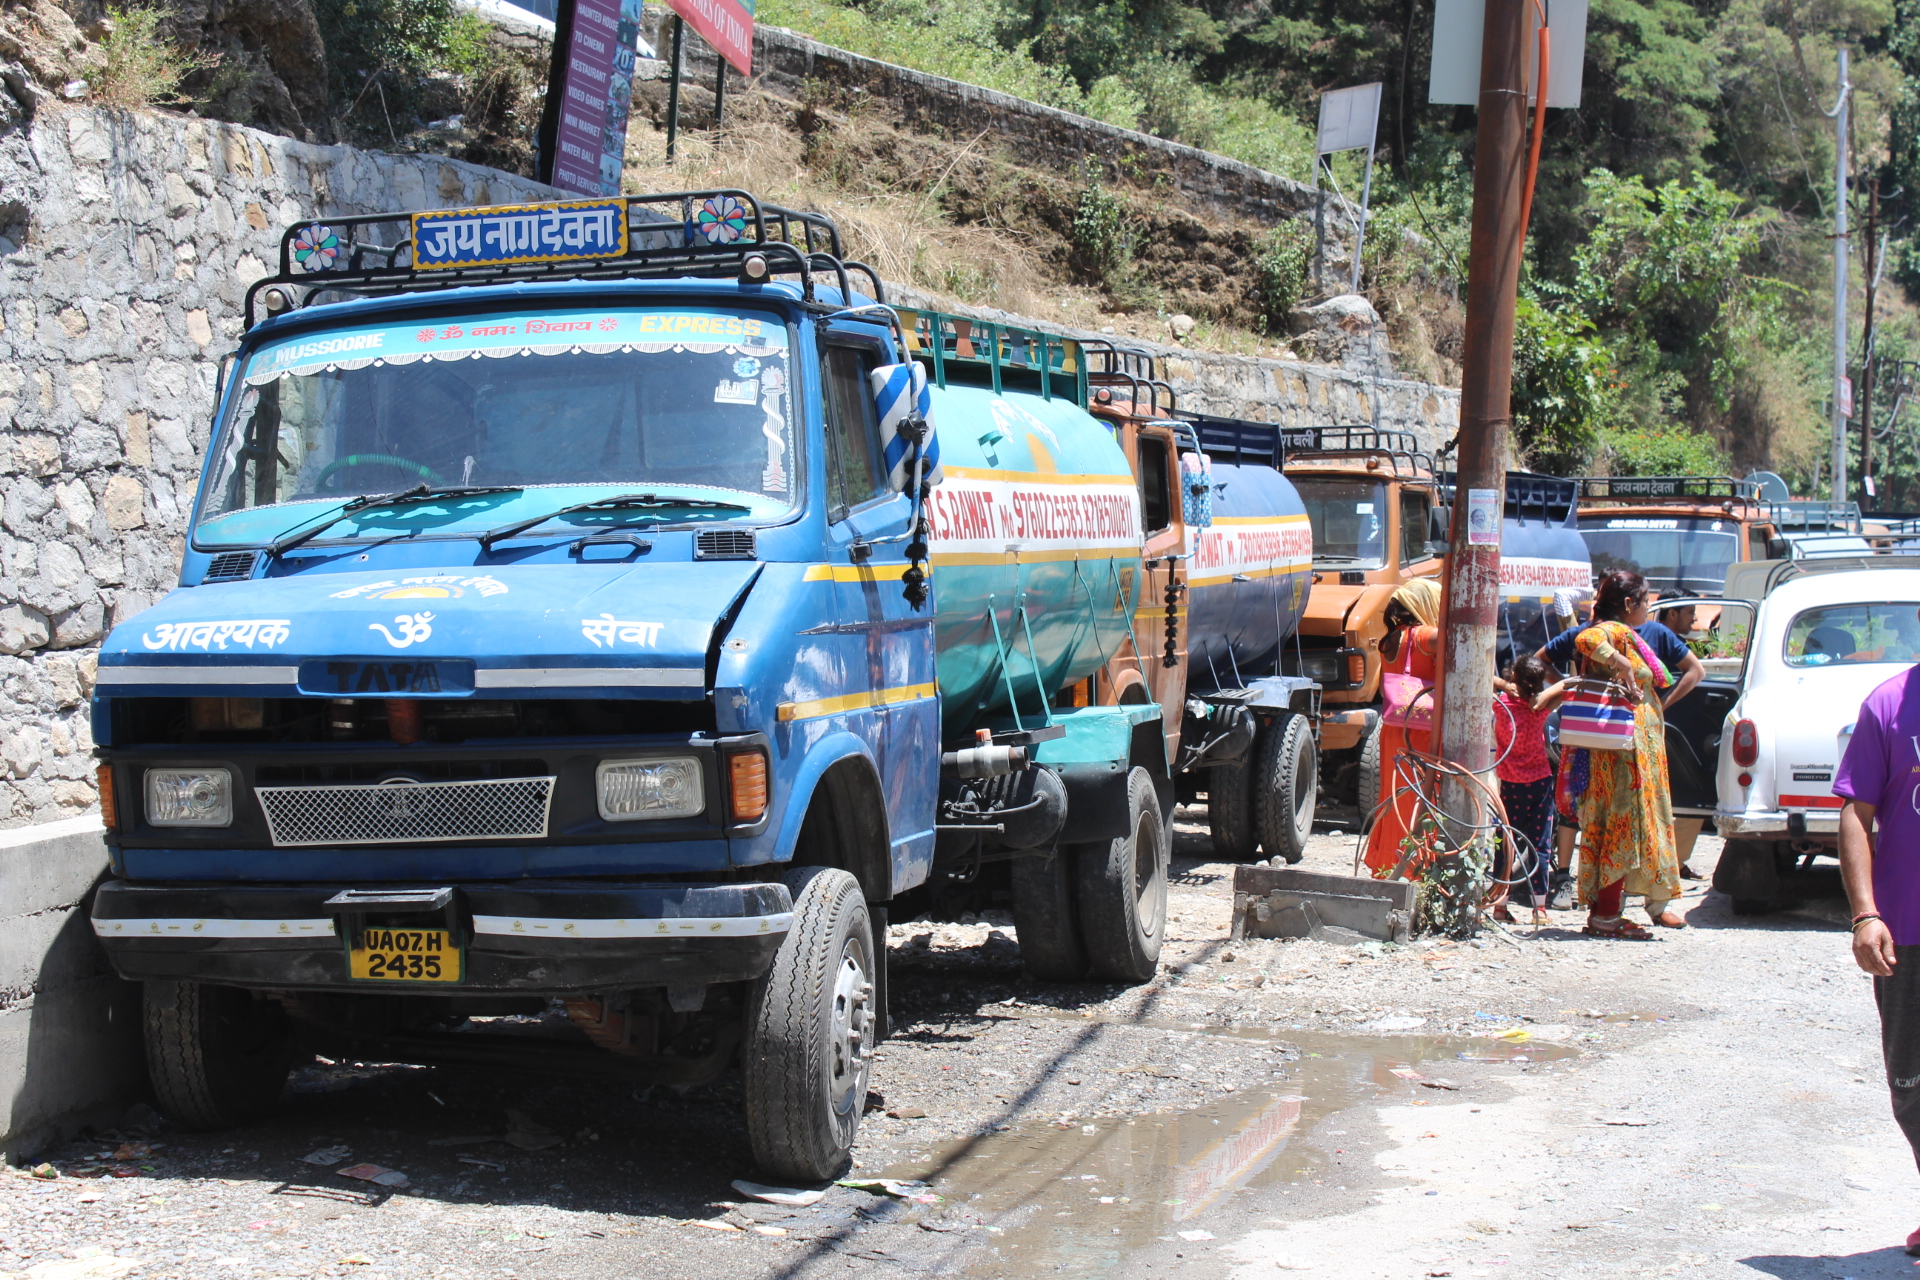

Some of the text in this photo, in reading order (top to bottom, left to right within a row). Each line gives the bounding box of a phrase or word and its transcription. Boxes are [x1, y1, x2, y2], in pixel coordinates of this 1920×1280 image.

[577, 3, 619, 32] HAUNTED HOUSE
[714, 3, 726, 34] OF
[726, 14, 748, 58] INDIA
[574, 30, 605, 54] 7D CINEMA
[571, 58, 607, 83] RESTAURANT
[568, 85, 605, 111] VIDEO GAMES
[564, 113, 601, 138] MINI MARKET
[561, 140, 595, 164] WATER BALL
[558, 168, 576, 185] PHOTO
[422, 208, 615, 259] जय नाग देवता
[470, 325, 517, 338] नमः
[524, 319, 594, 335] शिवाय
[639, 315, 762, 337] EXPRESS
[275, 332, 386, 364] MUSSOORIE
[1613, 482, 1632, 494] जय
[1632, 482, 1650, 494] नाग
[142, 619, 291, 651] आवश्यक
[581, 613, 665, 649] सेवा
[327, 662, 442, 693] TATA
[368, 953, 442, 979] 2435
